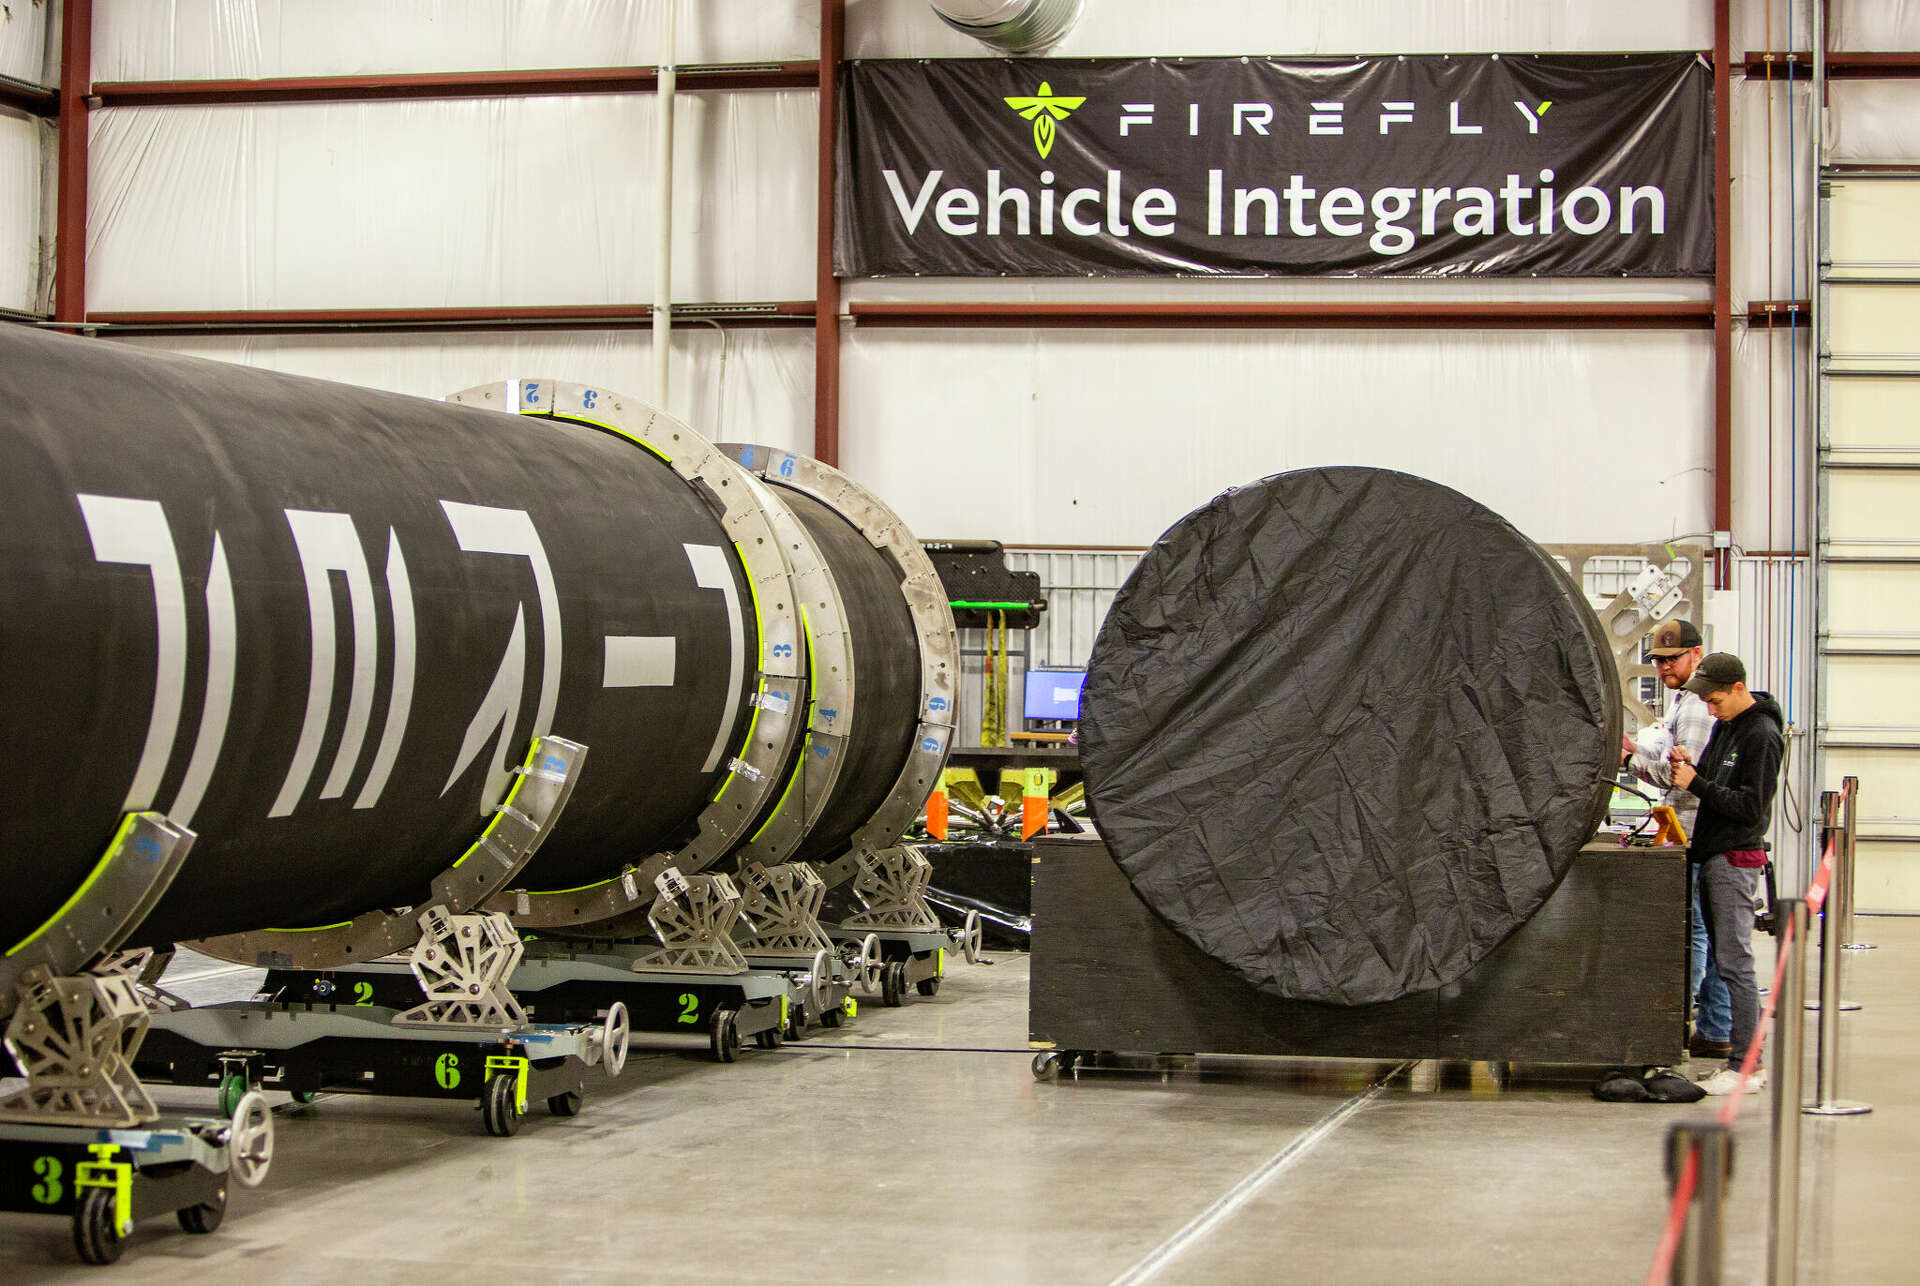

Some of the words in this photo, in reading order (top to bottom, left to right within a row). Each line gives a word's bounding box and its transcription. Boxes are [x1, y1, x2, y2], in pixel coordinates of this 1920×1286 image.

[1119, 100, 1553, 137] FIREFLY
[882, 169, 1177, 238] Vehicle
[1206, 168, 1666, 256] Integration
[525, 383, 539, 403] 2
[583, 389, 598, 409] 3
[773, 643, 792, 658] 3
[353, 981, 374, 1007] 2
[677, 993, 699, 1024] 2
[434, 1052, 461, 1089] 6
[31, 1155, 63, 1205] 3
